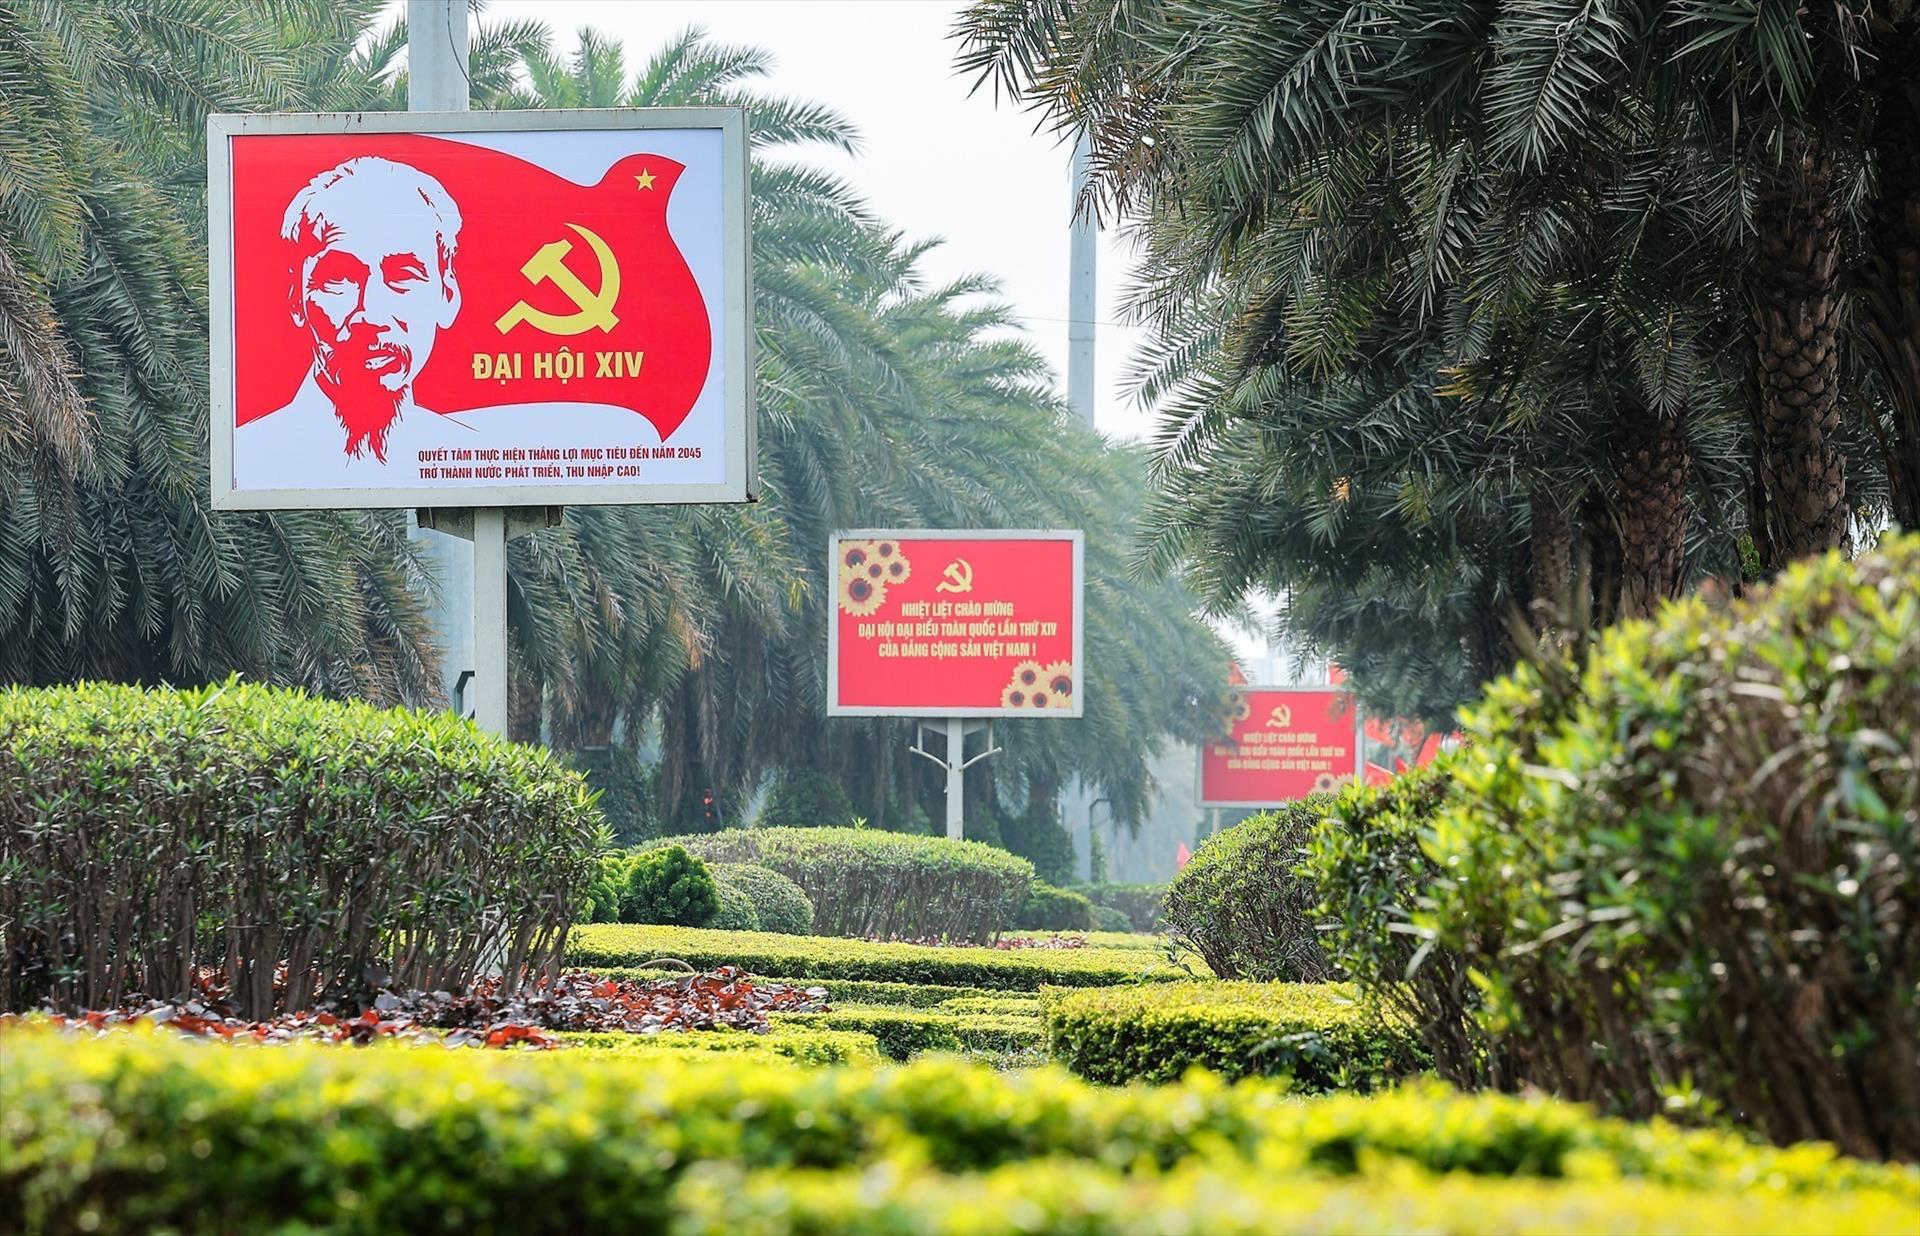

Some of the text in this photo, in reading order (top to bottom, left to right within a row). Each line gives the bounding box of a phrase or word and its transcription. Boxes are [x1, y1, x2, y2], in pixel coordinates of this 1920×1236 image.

[472, 346, 644, 385] ĐẠI HỘI XIV
[418, 444, 702, 463] QUYẾT TÂM THỰC HIỆN THẮNG LỢI MỤC TIÊU ĐẾN NĂM 2045
[419, 462, 641, 479] TRỞ THÀNH NƯỚC PHÁT TRIỂN, THU NHẬP CAO!
[902, 600, 930, 619] NHIỆT
[932, 600, 953, 619] LIỆT
[955, 600, 981, 616] CHÀO
[858, 623, 875, 640] ĐẠI
[878, 620, 894, 640] HỘI
[896, 623, 913, 639] ĐẠI
[916, 618, 938, 637] BIỂU
[940, 620, 967, 637] TOÀN
[969, 618, 996, 638] QUỐC
[1019, 619, 1040, 636] THỨ
[1041, 622, 1057, 636] XIV
[879, 639, 899, 657] CỦA
[901, 639, 928, 657] ĐẢNG
[931, 640, 958, 660] CỘNG
[960, 639, 981, 656] SẢN
[983, 640, 1005, 659] VIỆT
[1006, 643, 1030, 656] NAM
